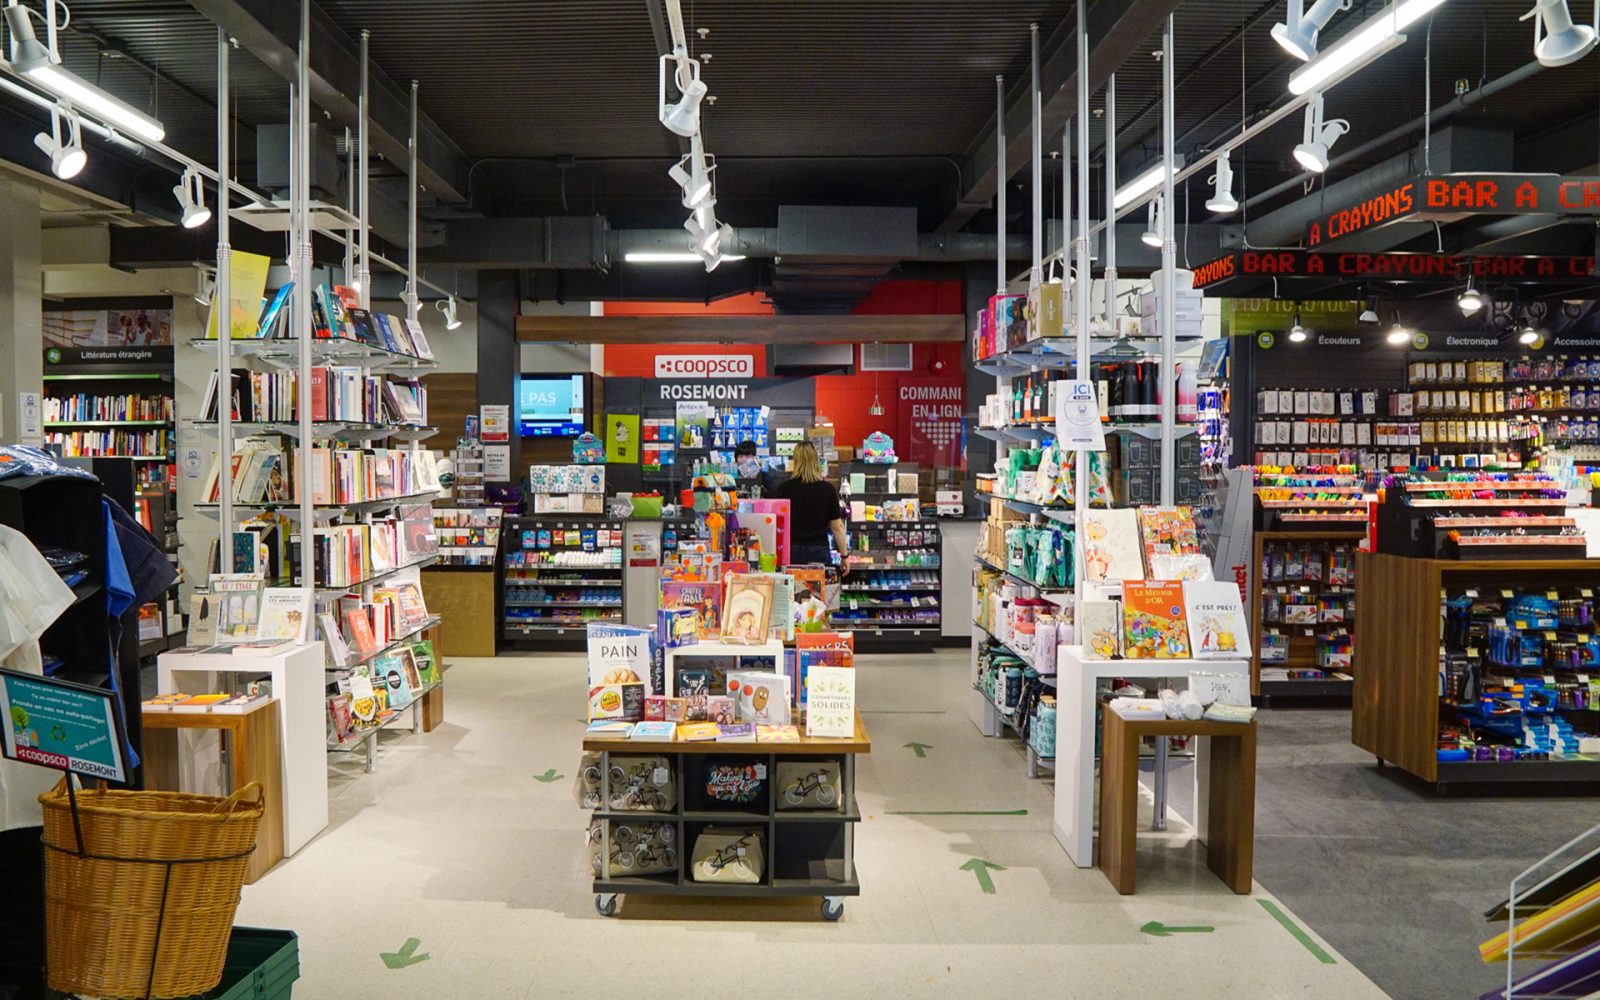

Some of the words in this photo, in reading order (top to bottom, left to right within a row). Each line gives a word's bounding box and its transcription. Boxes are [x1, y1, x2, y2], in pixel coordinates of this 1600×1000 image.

[1427, 180, 1498, 207] BAR
[1328, 183, 1413, 239] CRAYONS
[1243, 253, 1295, 273] BAR
[1338, 254, 1463, 274] CRAYONS
[1474, 256, 1525, 276] BAR
[1318, 334, 1361, 345] Écouteurs
[1446, 335, 1499, 347] Électronique
[81, 350, 117, 359] Littérature
[118, 350, 152, 360] étrangère
[674, 359, 748, 378] coopsco
[660, 384, 748, 400] ROSEMONT
[1074, 384, 1091, 395] ICI
[529, 391, 557, 404] PAS
[912, 405, 929, 418] EN
[601, 645, 638, 658] PAIN
[811, 701, 852, 710] SOLIDES
[26, 750, 67, 767] coopsco
[71, 760, 117, 777] ROSEMONT
